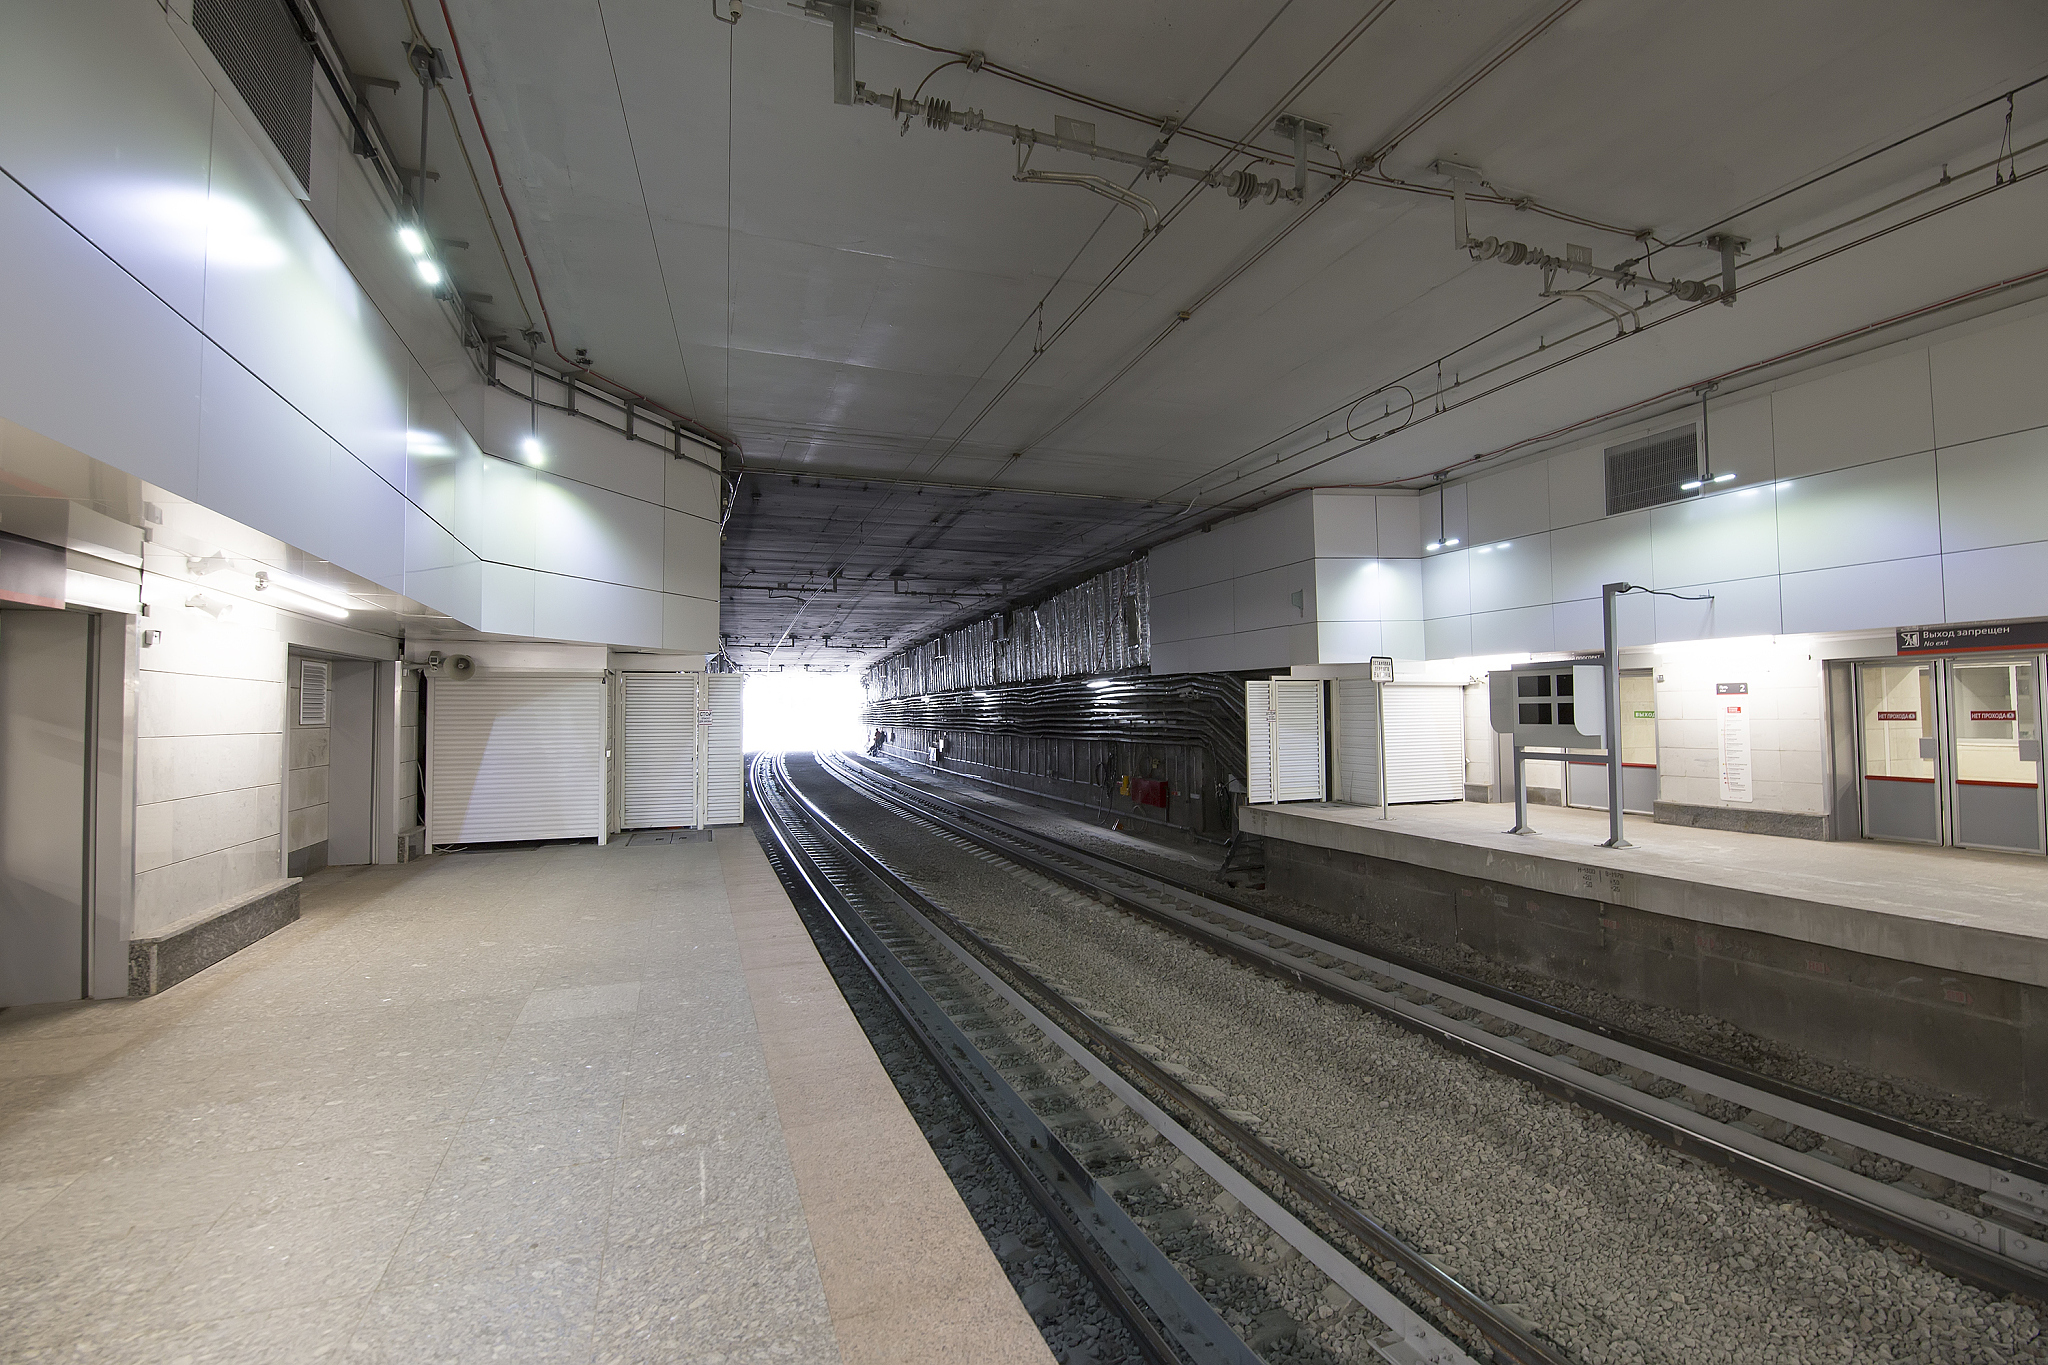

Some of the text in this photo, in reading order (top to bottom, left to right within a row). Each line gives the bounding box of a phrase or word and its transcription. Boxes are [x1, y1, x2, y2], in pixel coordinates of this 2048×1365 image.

[1923, 626, 2010, 639] Выход запрещен
[1739, 684, 1746, 692] 2
